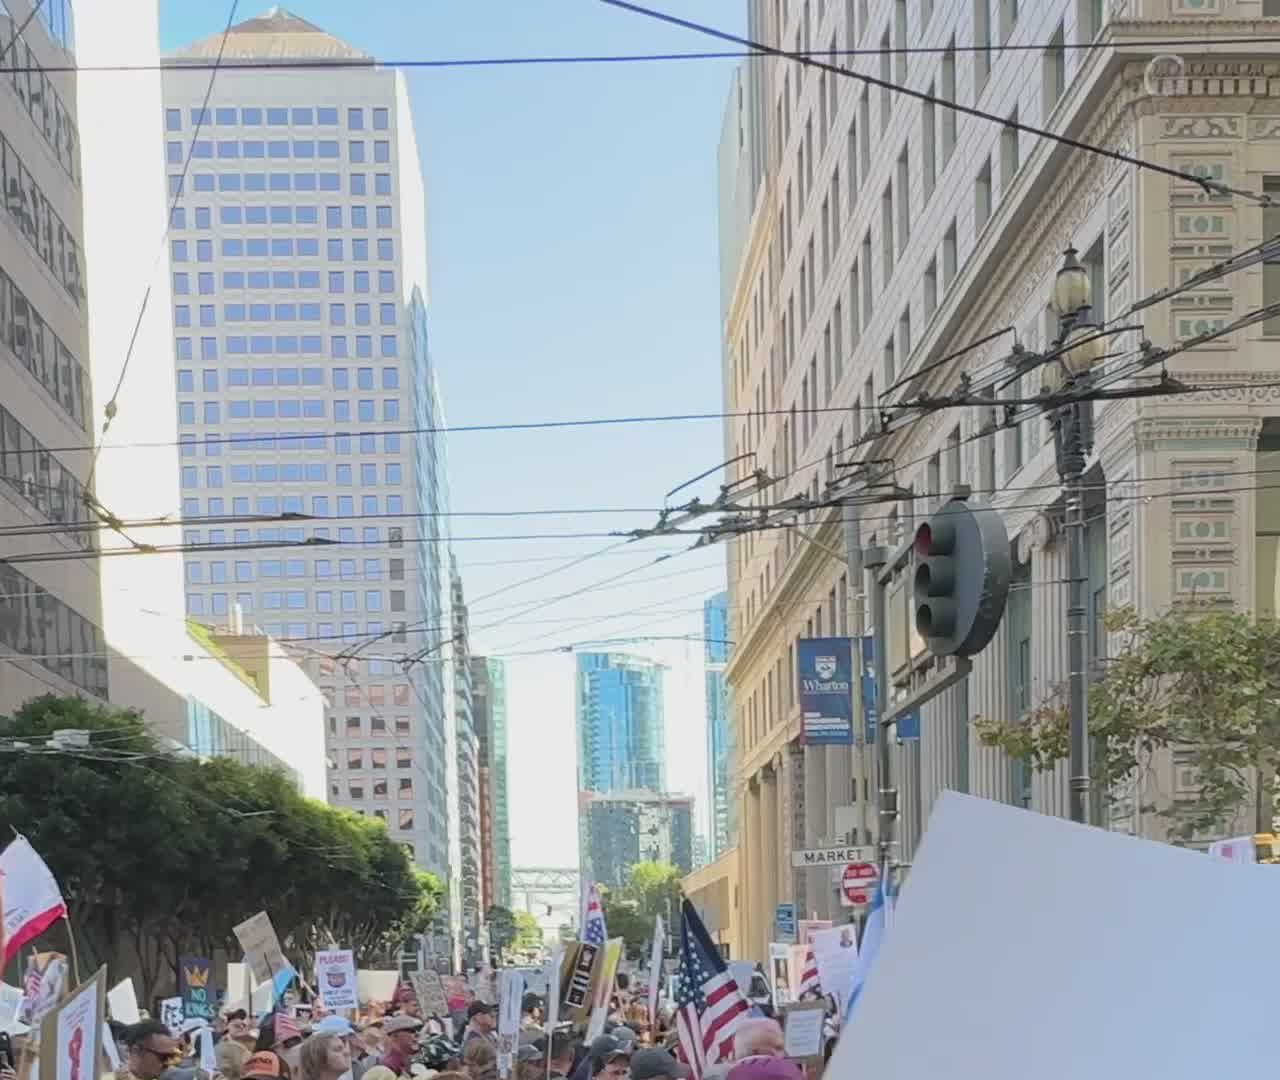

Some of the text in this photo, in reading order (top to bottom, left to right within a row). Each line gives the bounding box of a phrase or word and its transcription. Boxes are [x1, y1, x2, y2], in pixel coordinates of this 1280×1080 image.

[803, 680, 849, 691] Wharton
[804, 849, 865, 863] MARKET
[191, 989, 207, 1001] NO
